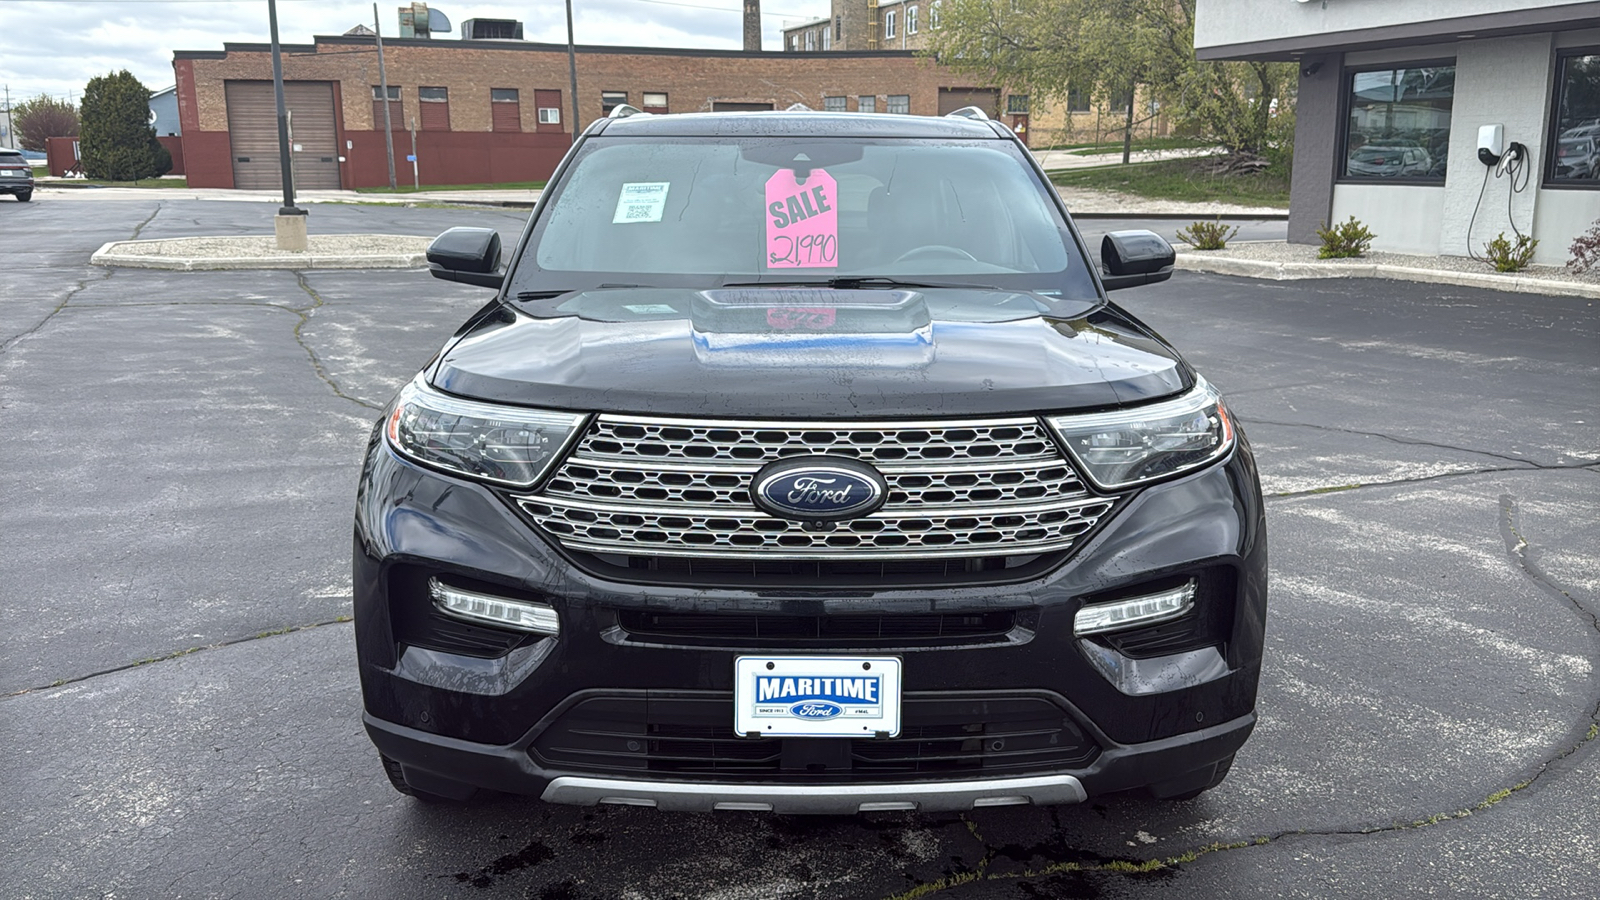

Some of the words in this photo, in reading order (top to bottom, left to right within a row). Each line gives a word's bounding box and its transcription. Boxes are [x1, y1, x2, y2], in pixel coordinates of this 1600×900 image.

[769, 185, 831, 229] SALE
[770, 234, 837, 266] $21,990
[787, 477, 853, 504] Ford
[759, 677, 877, 702] MARITIME
[799, 704, 833, 716] Ford
